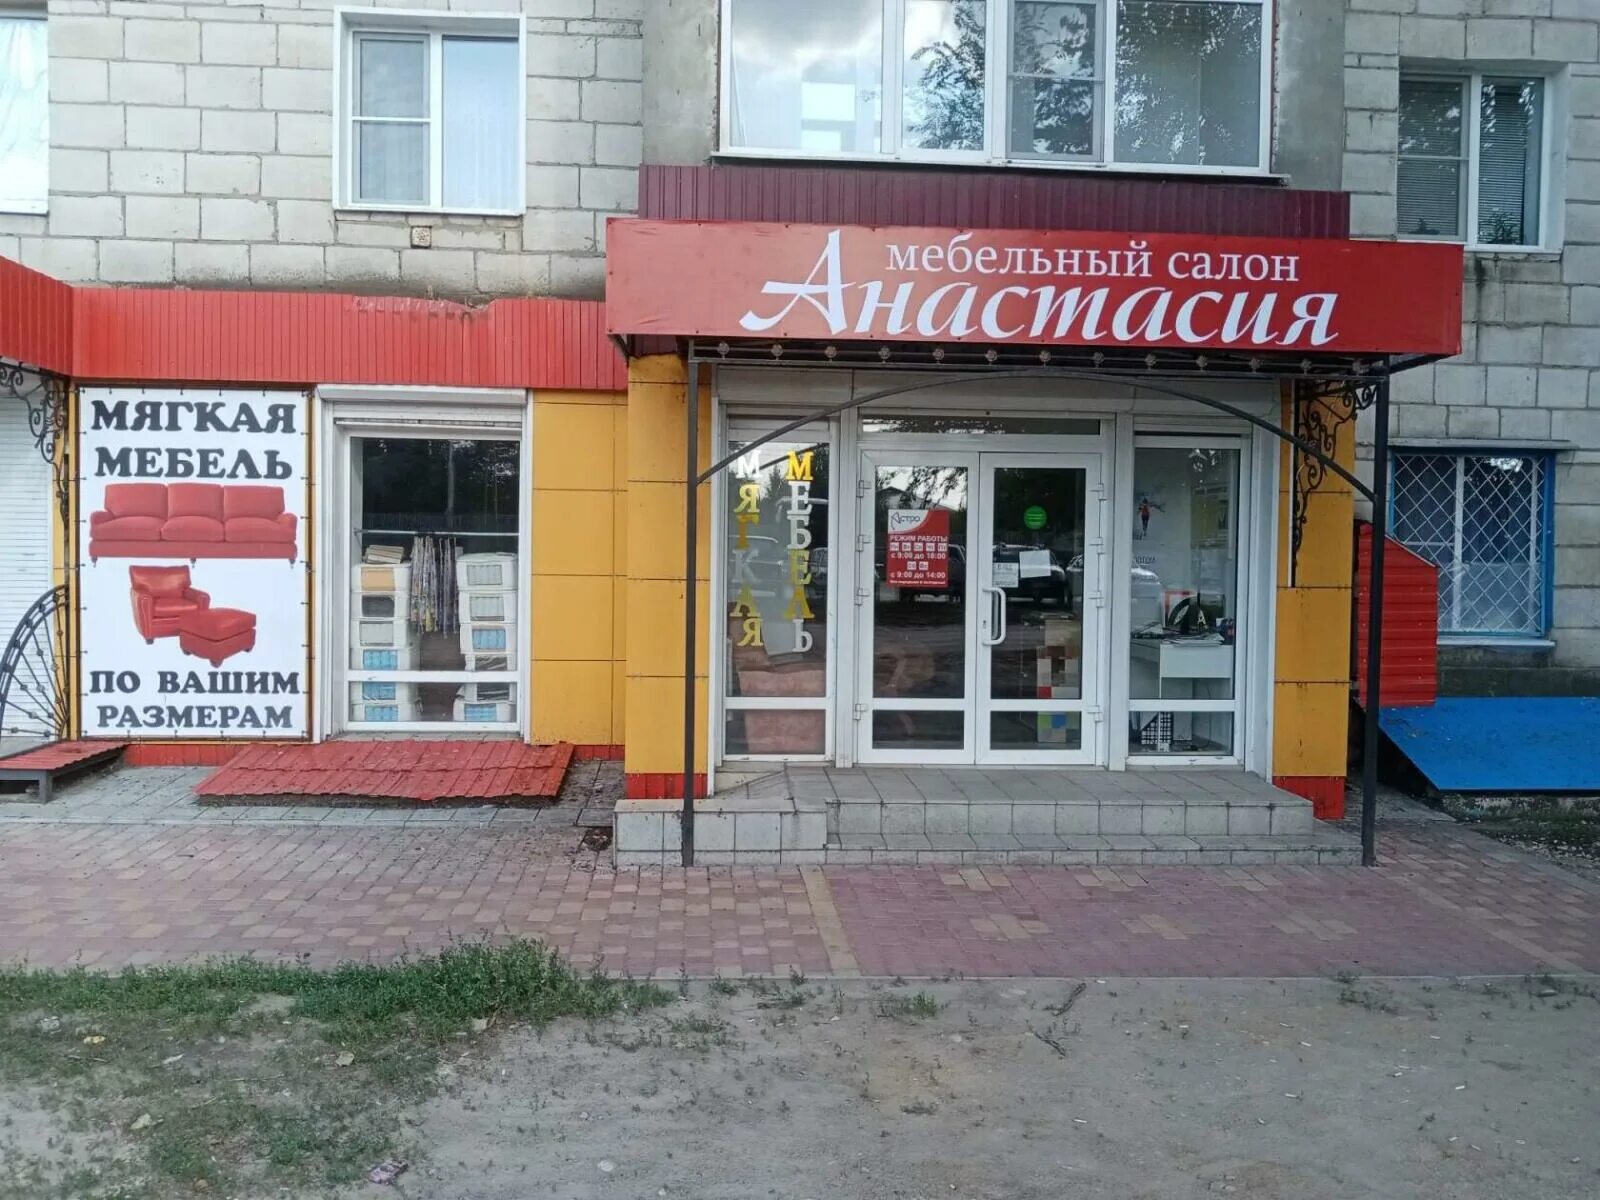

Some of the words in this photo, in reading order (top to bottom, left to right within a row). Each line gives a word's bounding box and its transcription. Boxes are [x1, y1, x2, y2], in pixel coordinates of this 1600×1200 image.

[885, 232, 1152, 278] мебельный
[1167, 248, 1300, 282] салон
[738, 229, 1338, 346] Анастасия
[91, 400, 297, 434] МЯГКАЯ
[94, 447, 293, 480] МЕБЕЛЬ
[729, 450, 763, 647] МЯГКАЯ
[784, 450, 815, 653] МЕБЕЛЬ
[89, 671, 141, 694] ПО
[157, 671, 300, 695] ВАШИМ
[97, 705, 293, 729] РАЗМЕРАМ
